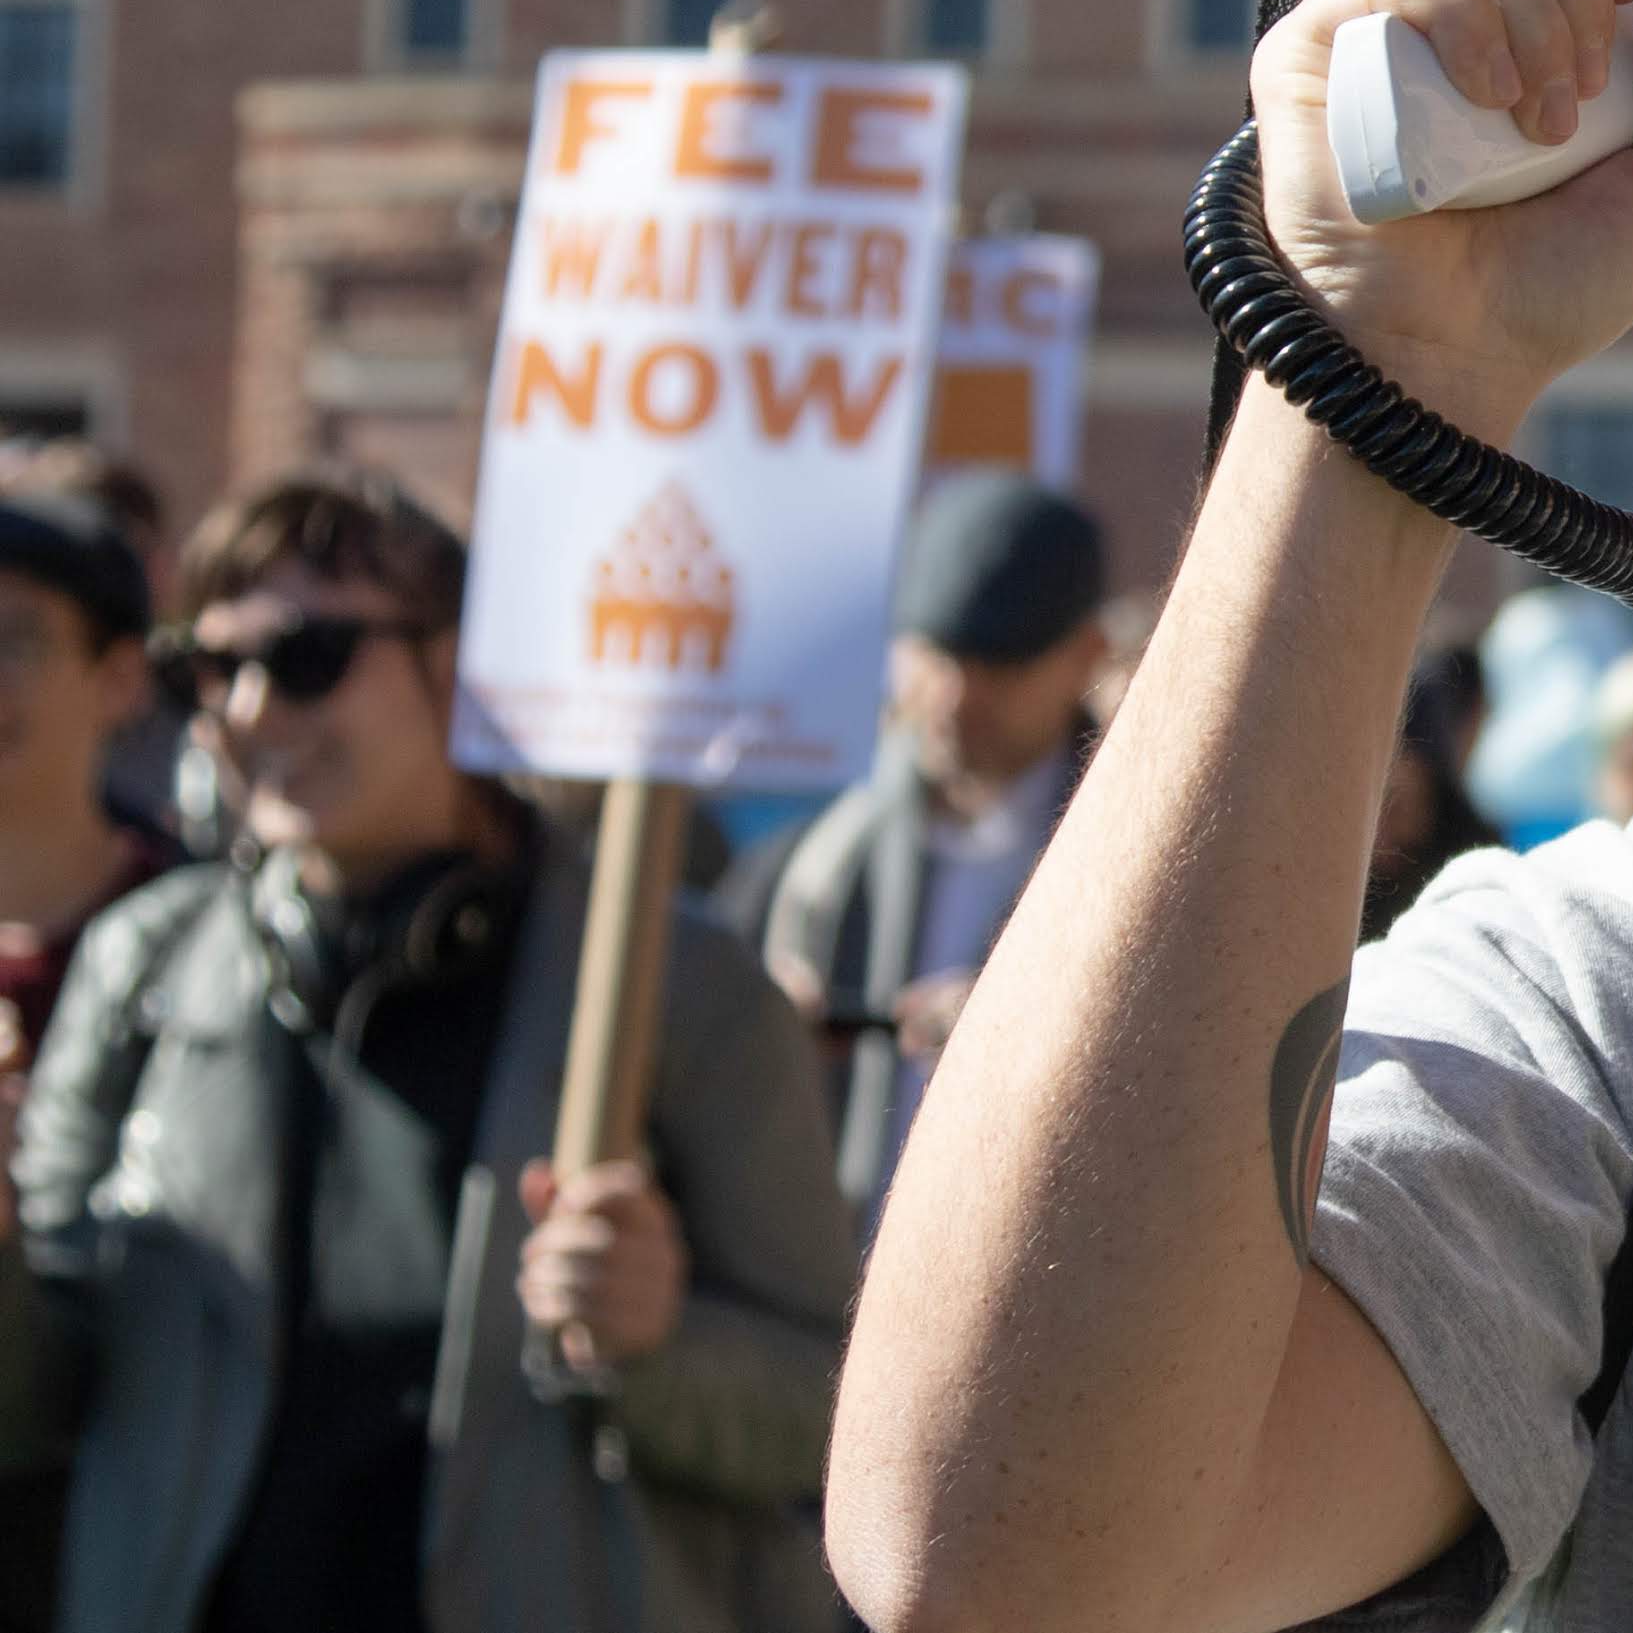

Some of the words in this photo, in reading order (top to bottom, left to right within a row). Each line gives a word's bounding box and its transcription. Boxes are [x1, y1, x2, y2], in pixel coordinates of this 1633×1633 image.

[556, 77, 936, 194] FEE
[540, 212, 910, 324] WAIVER
[506, 340, 906, 448] NOW
